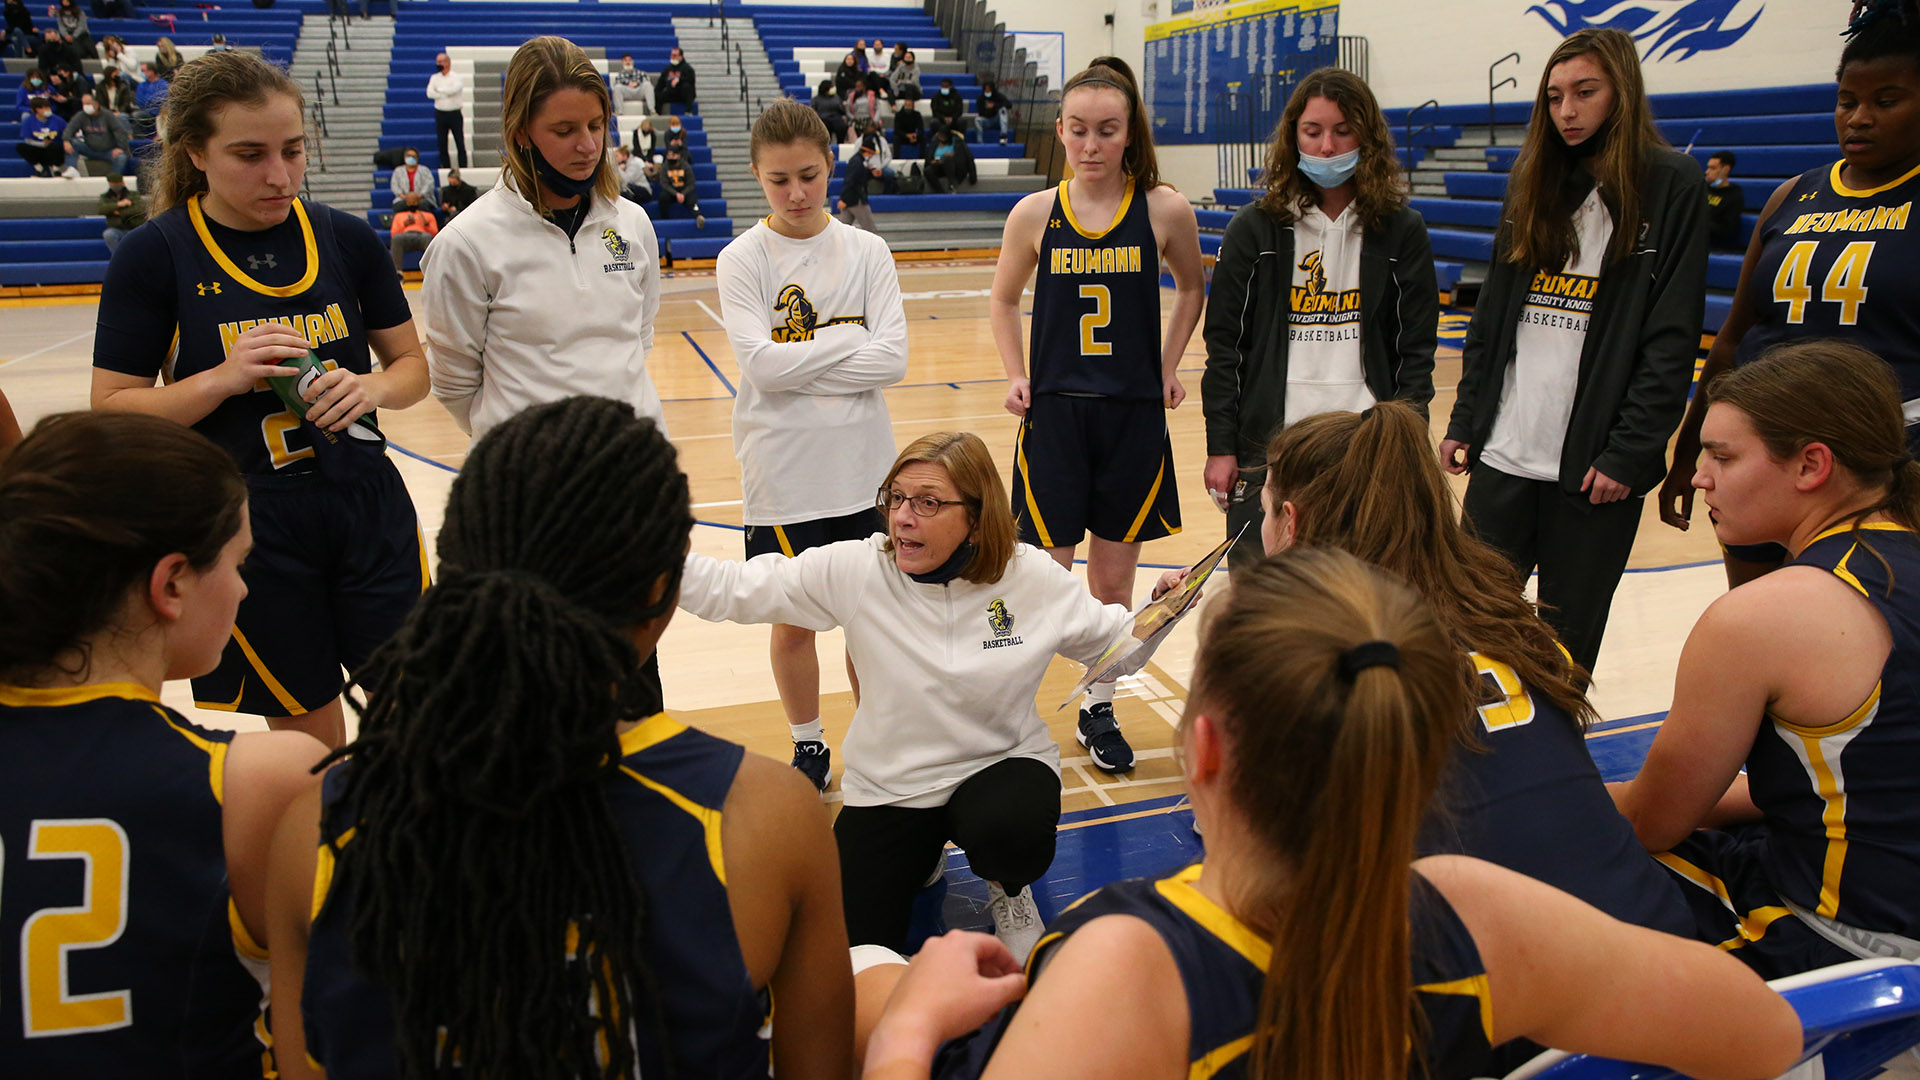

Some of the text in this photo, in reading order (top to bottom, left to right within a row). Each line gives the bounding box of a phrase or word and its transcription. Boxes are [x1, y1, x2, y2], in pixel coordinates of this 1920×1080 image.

[1783, 201, 1912, 235] NEUMANN
[1051, 246, 1141, 274] NEUMANN
[1773, 240, 1877, 325] 44
[1079, 284, 1112, 356] 2
[1290, 328, 1358, 342] BASKETBALL
[983, 636, 1024, 650] BASKETBALL
[0, 817, 133, 1039] 2
